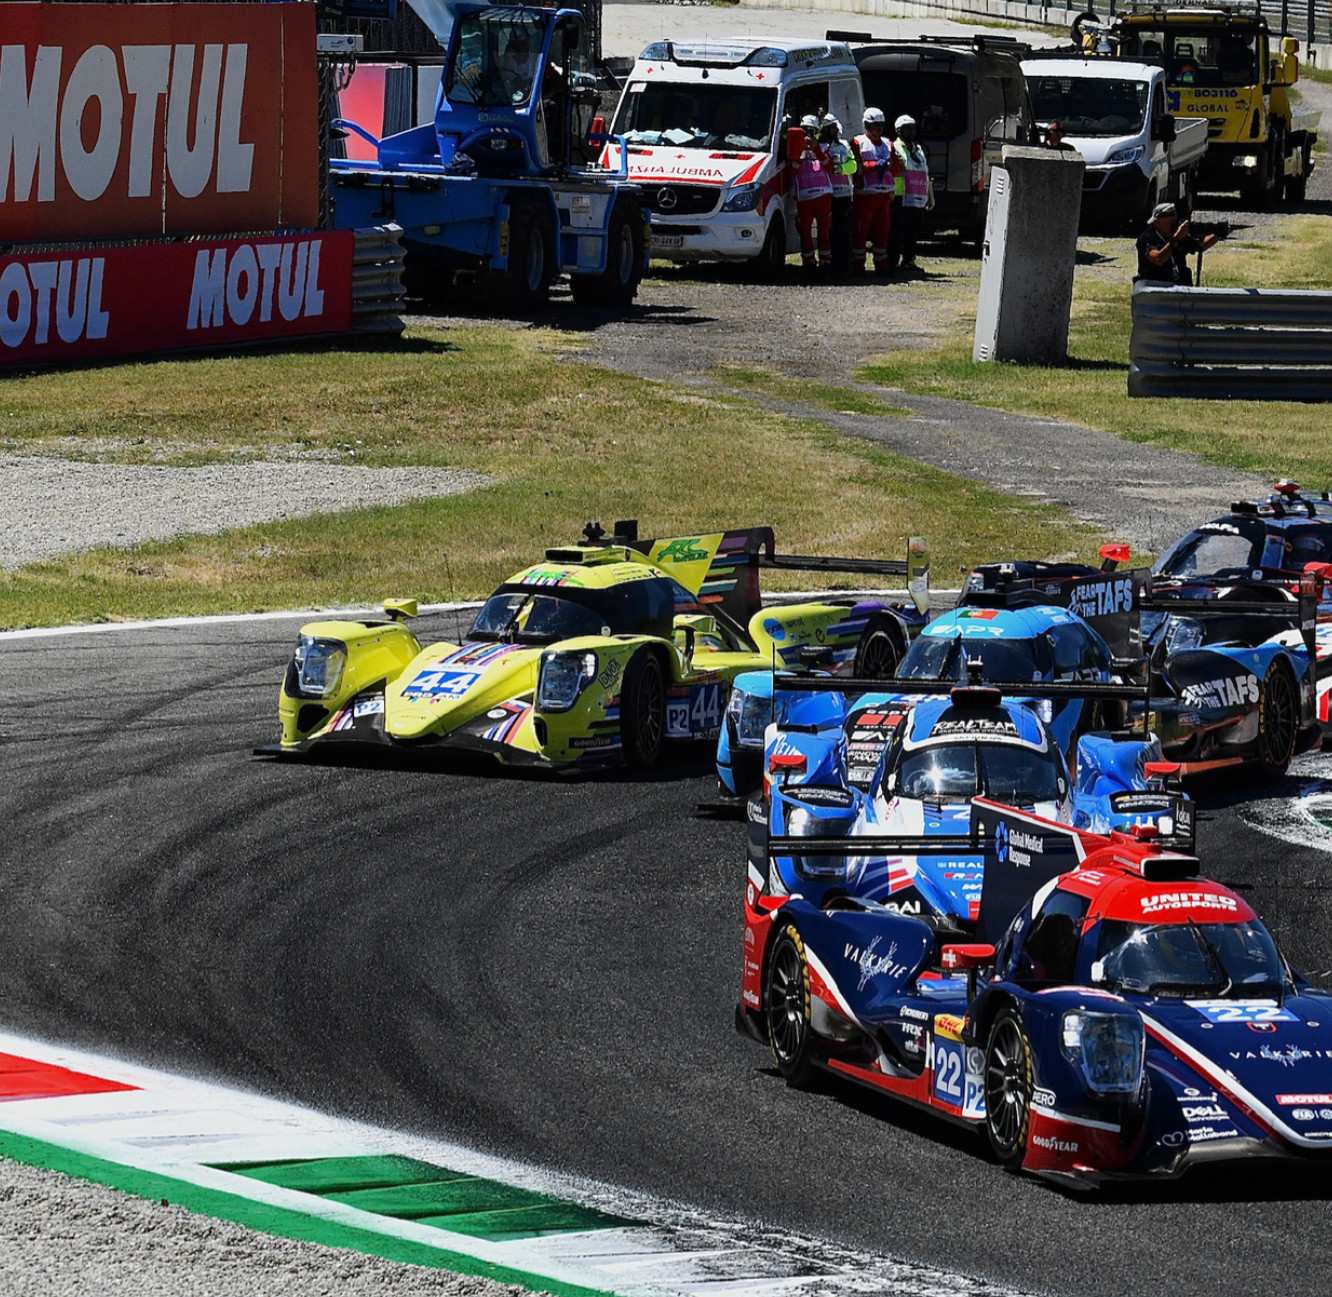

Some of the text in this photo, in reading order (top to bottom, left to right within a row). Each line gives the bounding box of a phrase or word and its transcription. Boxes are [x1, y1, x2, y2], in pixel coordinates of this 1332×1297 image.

[0, 43, 254, 202] MOTUL
[187, 240, 325, 330] MOTUL
[0, 257, 109, 347] OTUL
[1077, 583, 1101, 600] FEAR
[1096, 579, 1132, 615] TAFS
[1083, 601, 1096, 617] THE
[409, 671, 472, 693] 44
[1211, 675, 1259, 707] TAFS
[692, 685, 720, 727] 44
[669, 709, 688, 729] P2
[1009, 829, 1044, 853] Global Medical
[1009, 846, 1031, 867] Response
[1140, 893, 1237, 906] UNITED
[1142, 901, 1237, 914] AUTOSPORTS
[843, 943, 907, 980] VALKYRIE
[1207, 1006, 1291, 1021] 22
[936, 1047, 961, 1097] 22
[966, 1082, 985, 1111] P2
[1182, 1104, 1228, 1117] DELL
[1032, 1135, 1078, 1152] GOODYEAR
